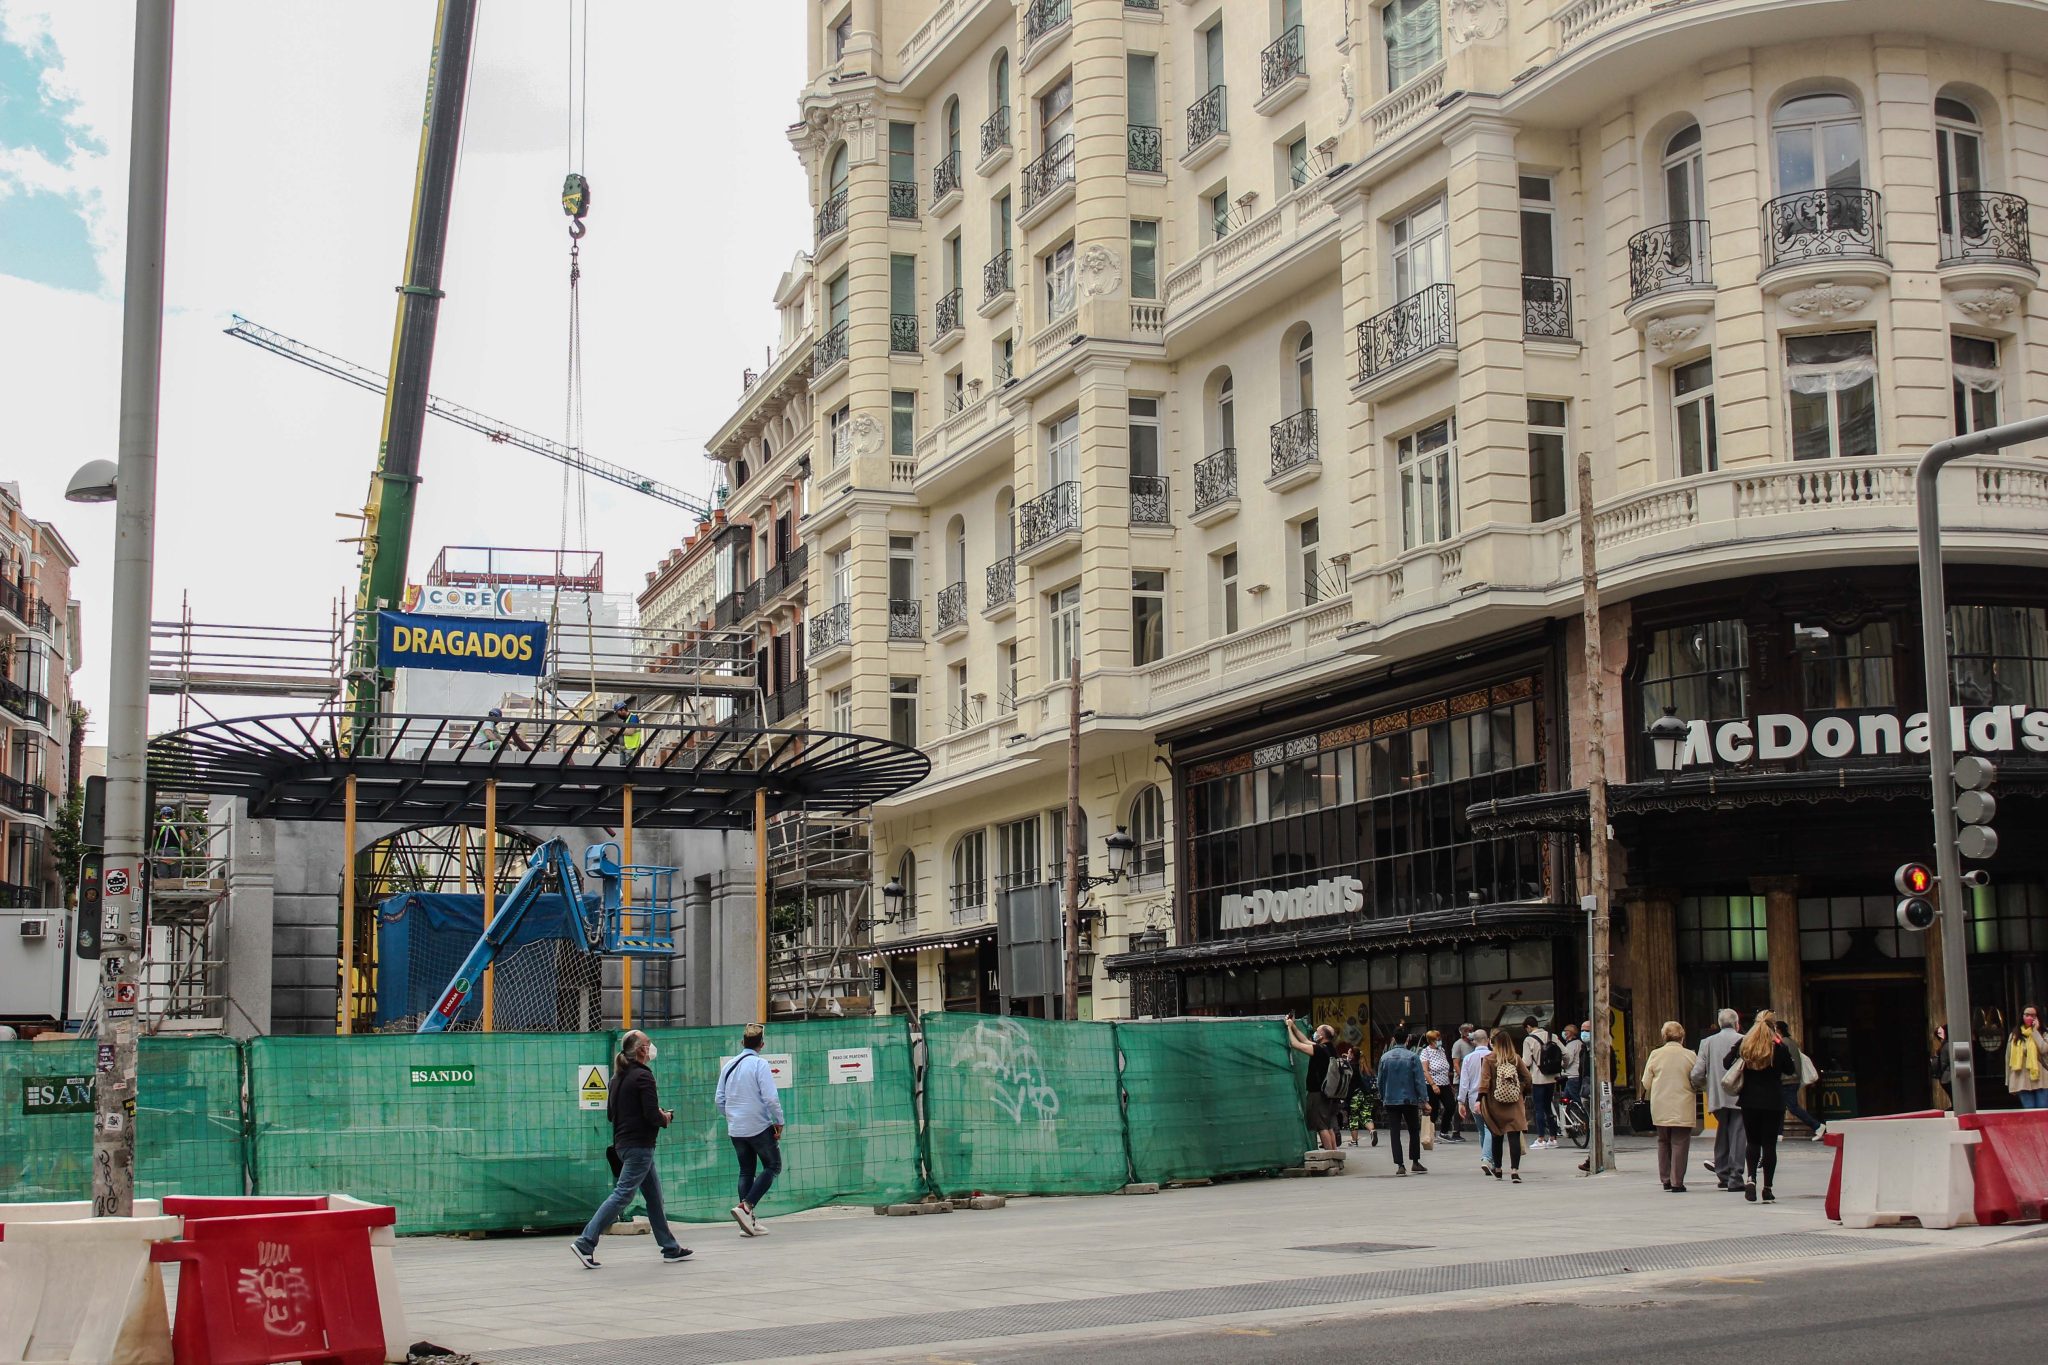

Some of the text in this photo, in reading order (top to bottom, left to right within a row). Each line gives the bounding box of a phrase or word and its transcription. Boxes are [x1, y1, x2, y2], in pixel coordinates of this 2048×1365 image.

[429, 590, 492, 606] CORE
[393, 626, 532, 661] DRAGADOS
[1220, 875, 1363, 930] McDonald's
[446, 992, 459, 1010] LOXAM
